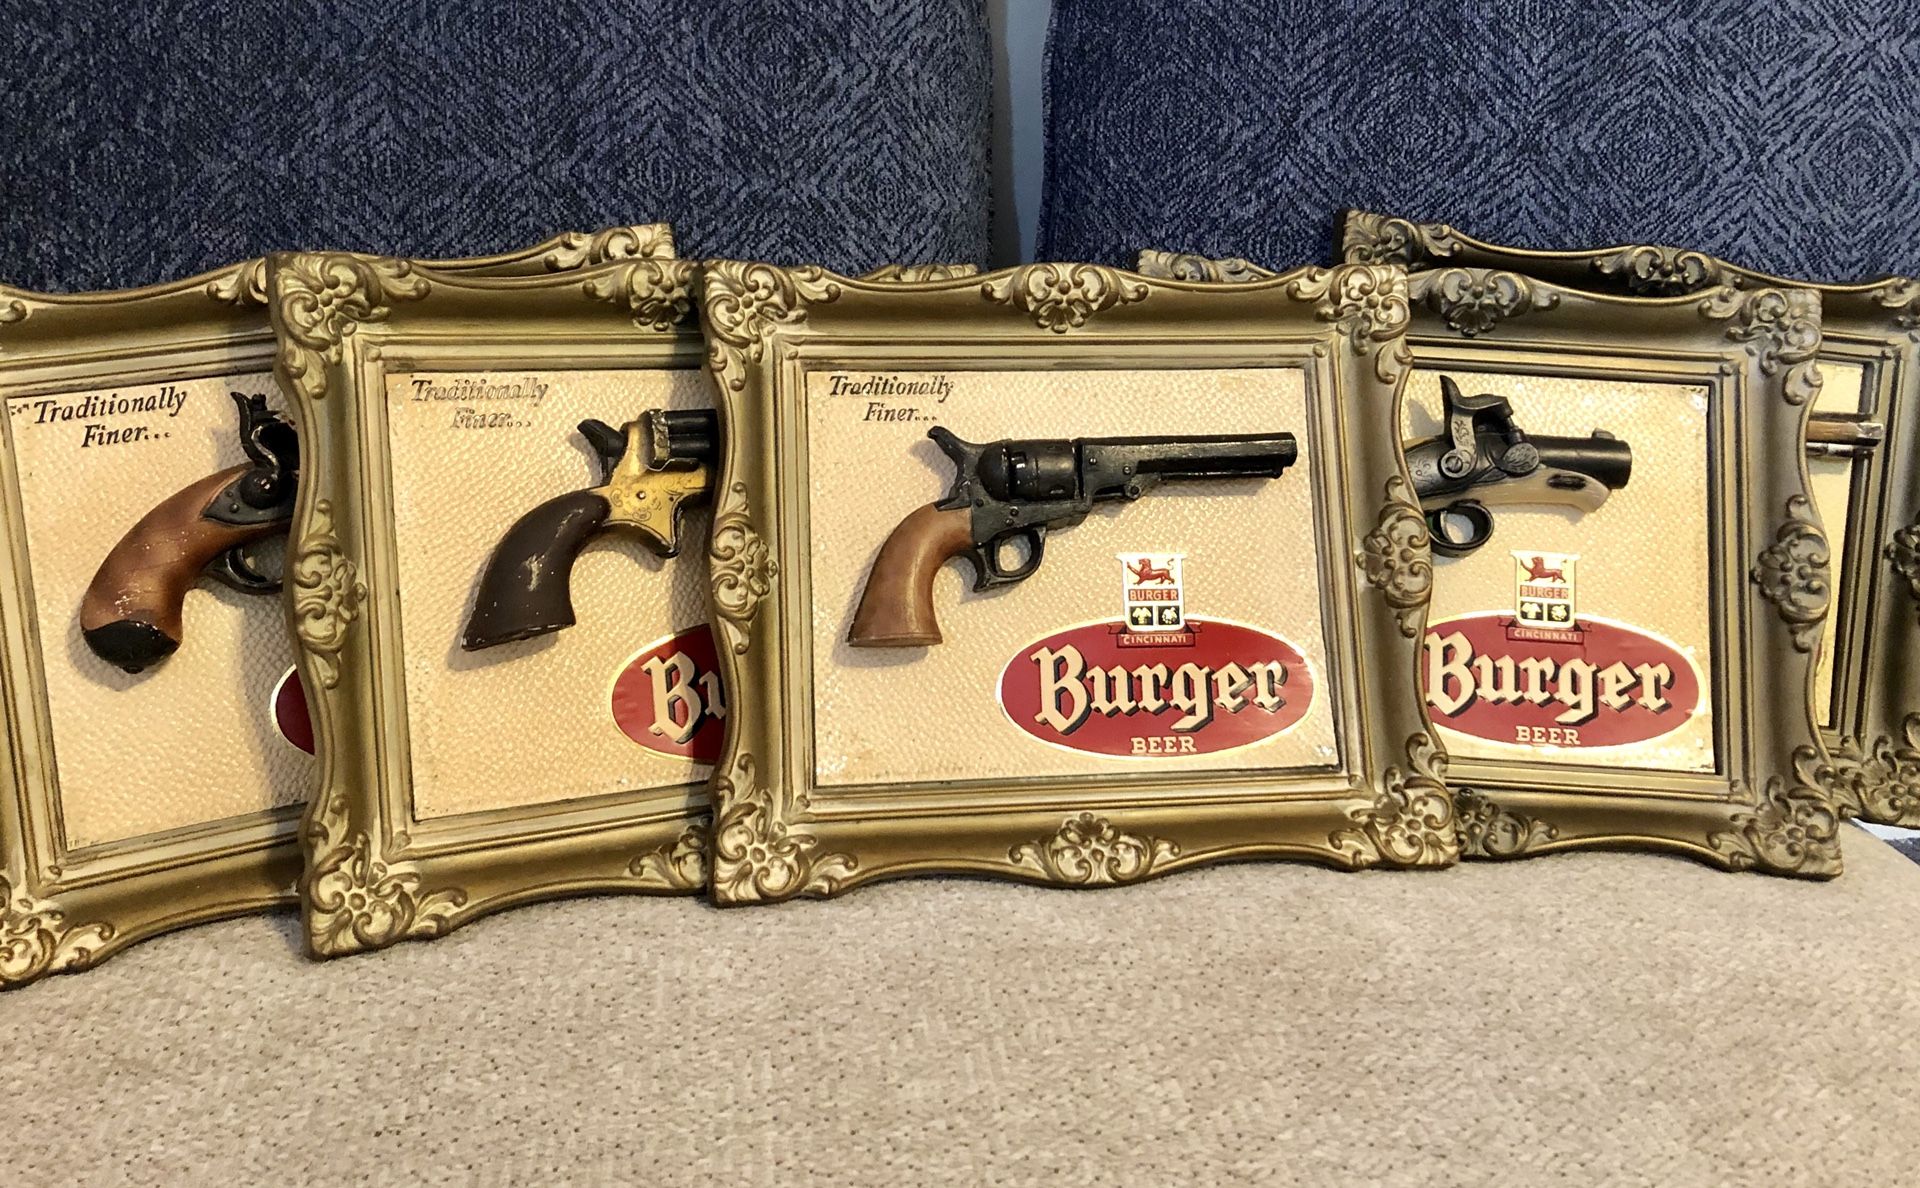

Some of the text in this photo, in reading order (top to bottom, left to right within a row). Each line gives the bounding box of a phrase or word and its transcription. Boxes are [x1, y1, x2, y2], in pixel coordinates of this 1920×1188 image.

[411, 377, 549, 407] Traditionally
[829, 375, 955, 404] Traditionally
[34, 386, 187, 424] Traditionally
[863, 402, 937, 422] Finer...
[81, 424, 172, 448] Finer...
[1129, 589, 1178, 601] BURGER
[1521, 586, 1569, 599] BURGER
[1122, 634, 1187, 645] CINCINNATI
[1514, 629, 1577, 641] CINCINNATI
[1424, 631, 1675, 726] Burger
[1030, 643, 1288, 735] Burger
[1130, 736, 1197, 754] BEER
[1515, 725, 1580, 745] BEER
